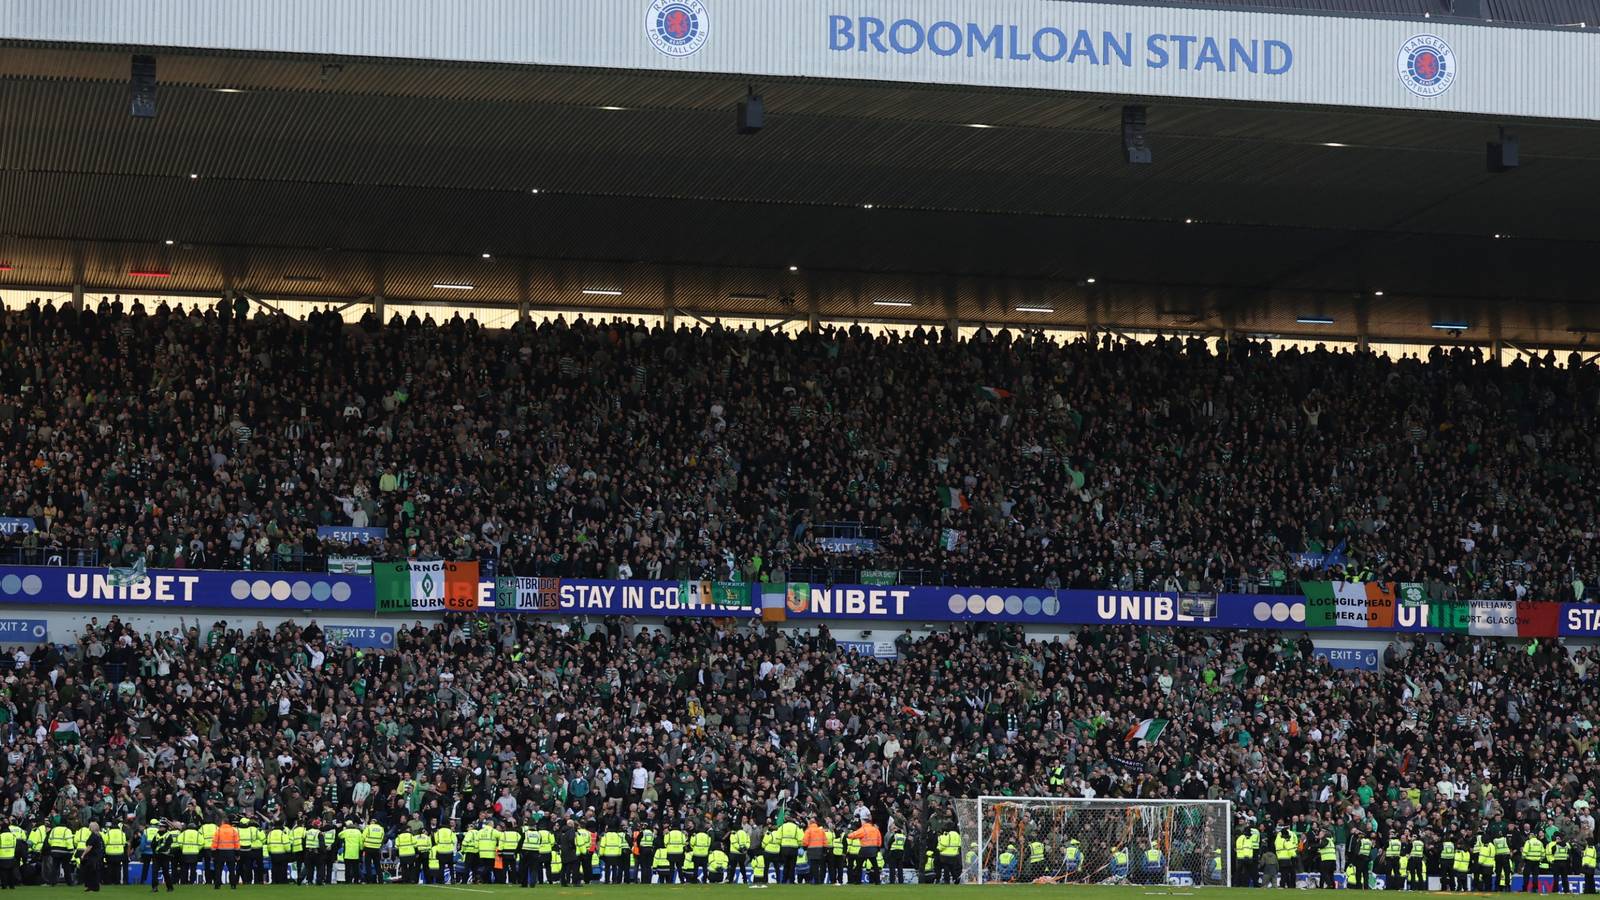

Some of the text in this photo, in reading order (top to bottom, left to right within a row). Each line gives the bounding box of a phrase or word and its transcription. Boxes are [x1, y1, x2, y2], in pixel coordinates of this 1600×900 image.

[688, 30, 705, 50] CLUB
[828, 15, 1293, 75] BROOMLOAN STAND
[1404, 37, 1450, 56] RANGERS
[1437, 71, 1453, 90] CLUB
[22, 522, 30, 533] 2
[333, 531, 370, 541] EXIT 3
[395, 564, 457, 572] GARNGAD
[67, 573, 199, 601] UNIBET
[498, 592, 512, 607] ST
[519, 592, 557, 608] JAMES
[560, 584, 616, 608] STAY
[622, 586, 643, 609] IN
[381, 598, 474, 608] MILLBURN CSC
[1310, 598, 1392, 607] LOCHGILPHEAD
[1470, 601, 1513, 609] WILLIAMS
[1325, 611, 1378, 620] EMERALD
[1460, 615, 1531, 624] PORT GLASGOW
[20, 622, 28, 632] 2
[342, 629, 376, 638] EXIT 3
[848, 643, 871, 653] EXIT
[1331, 650, 1361, 660] EXIT 5
